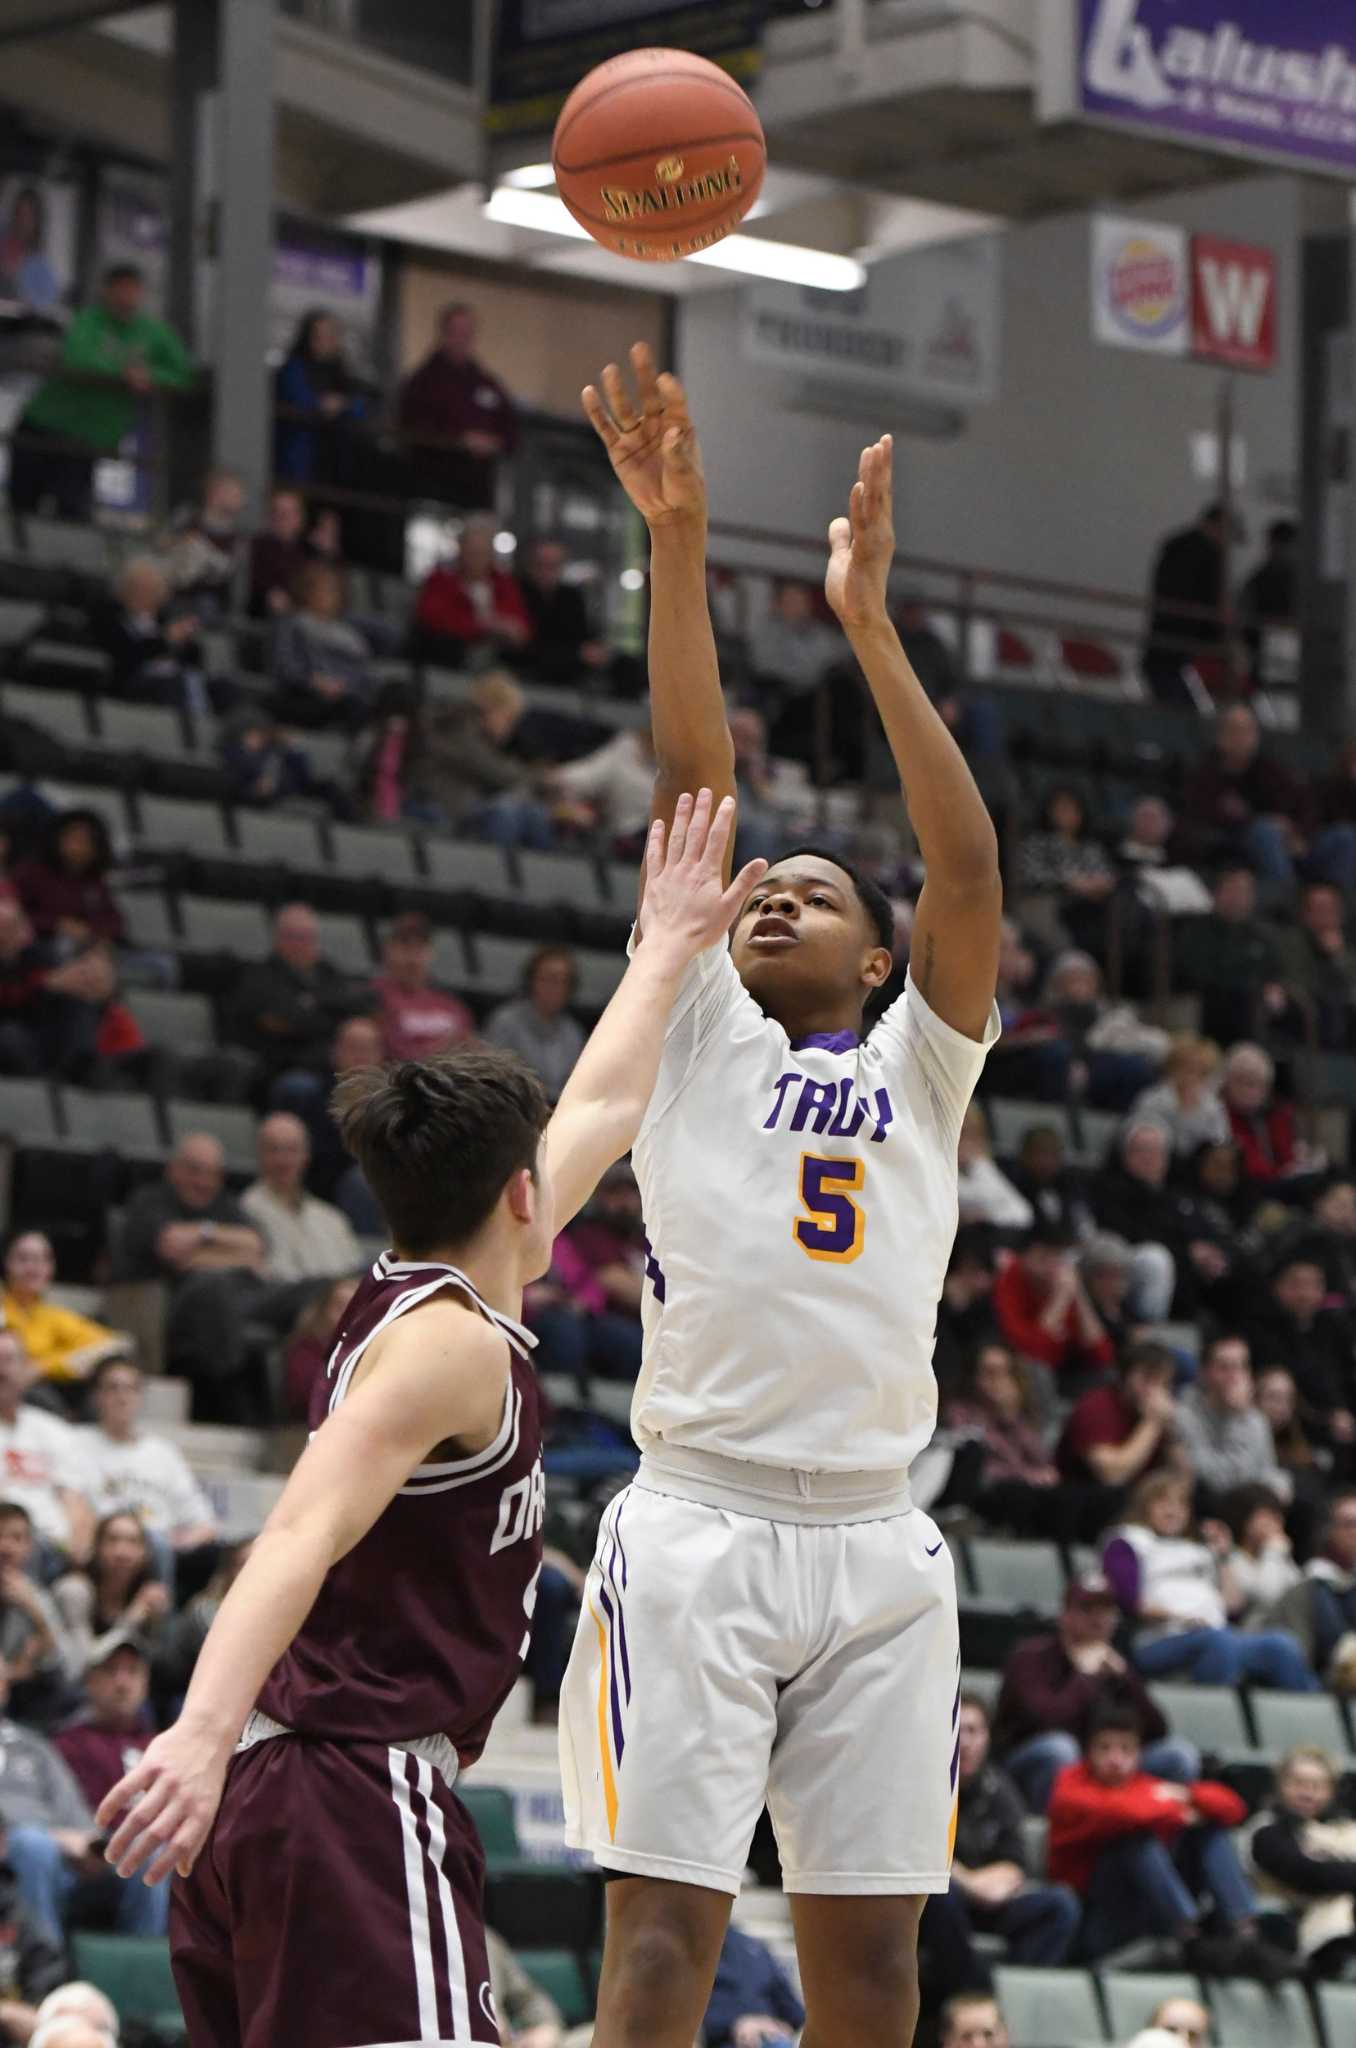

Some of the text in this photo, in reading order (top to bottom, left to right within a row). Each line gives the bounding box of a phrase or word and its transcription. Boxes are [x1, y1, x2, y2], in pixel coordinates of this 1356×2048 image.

[600, 154, 742, 223] SPALDING
[763, 1073, 894, 1143] TROY
[792, 1152, 865, 1264] 5
